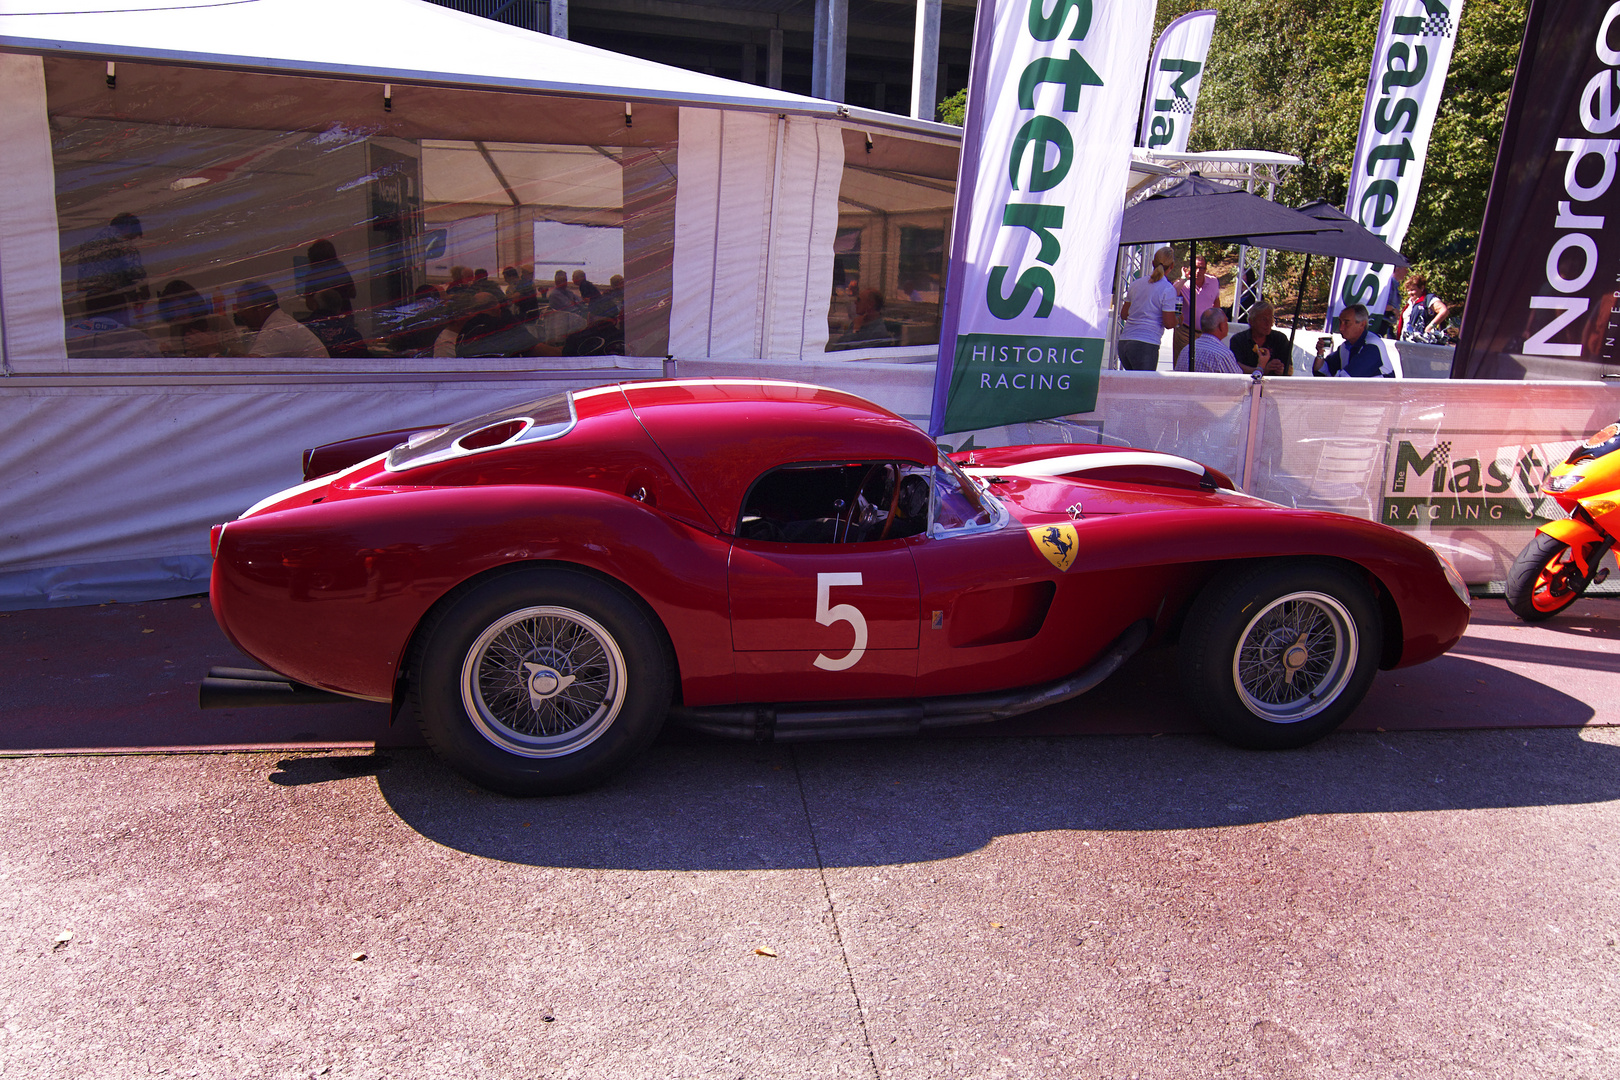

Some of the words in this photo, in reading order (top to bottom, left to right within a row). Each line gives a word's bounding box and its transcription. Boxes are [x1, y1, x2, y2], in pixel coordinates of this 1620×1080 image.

[972, 345, 1085, 364] HISTORIC
[980, 372, 1071, 390] RACING
[1394, 471, 1406, 490] The
[1389, 504, 1503, 520] RACING
[812, 571, 869, 672] 5
